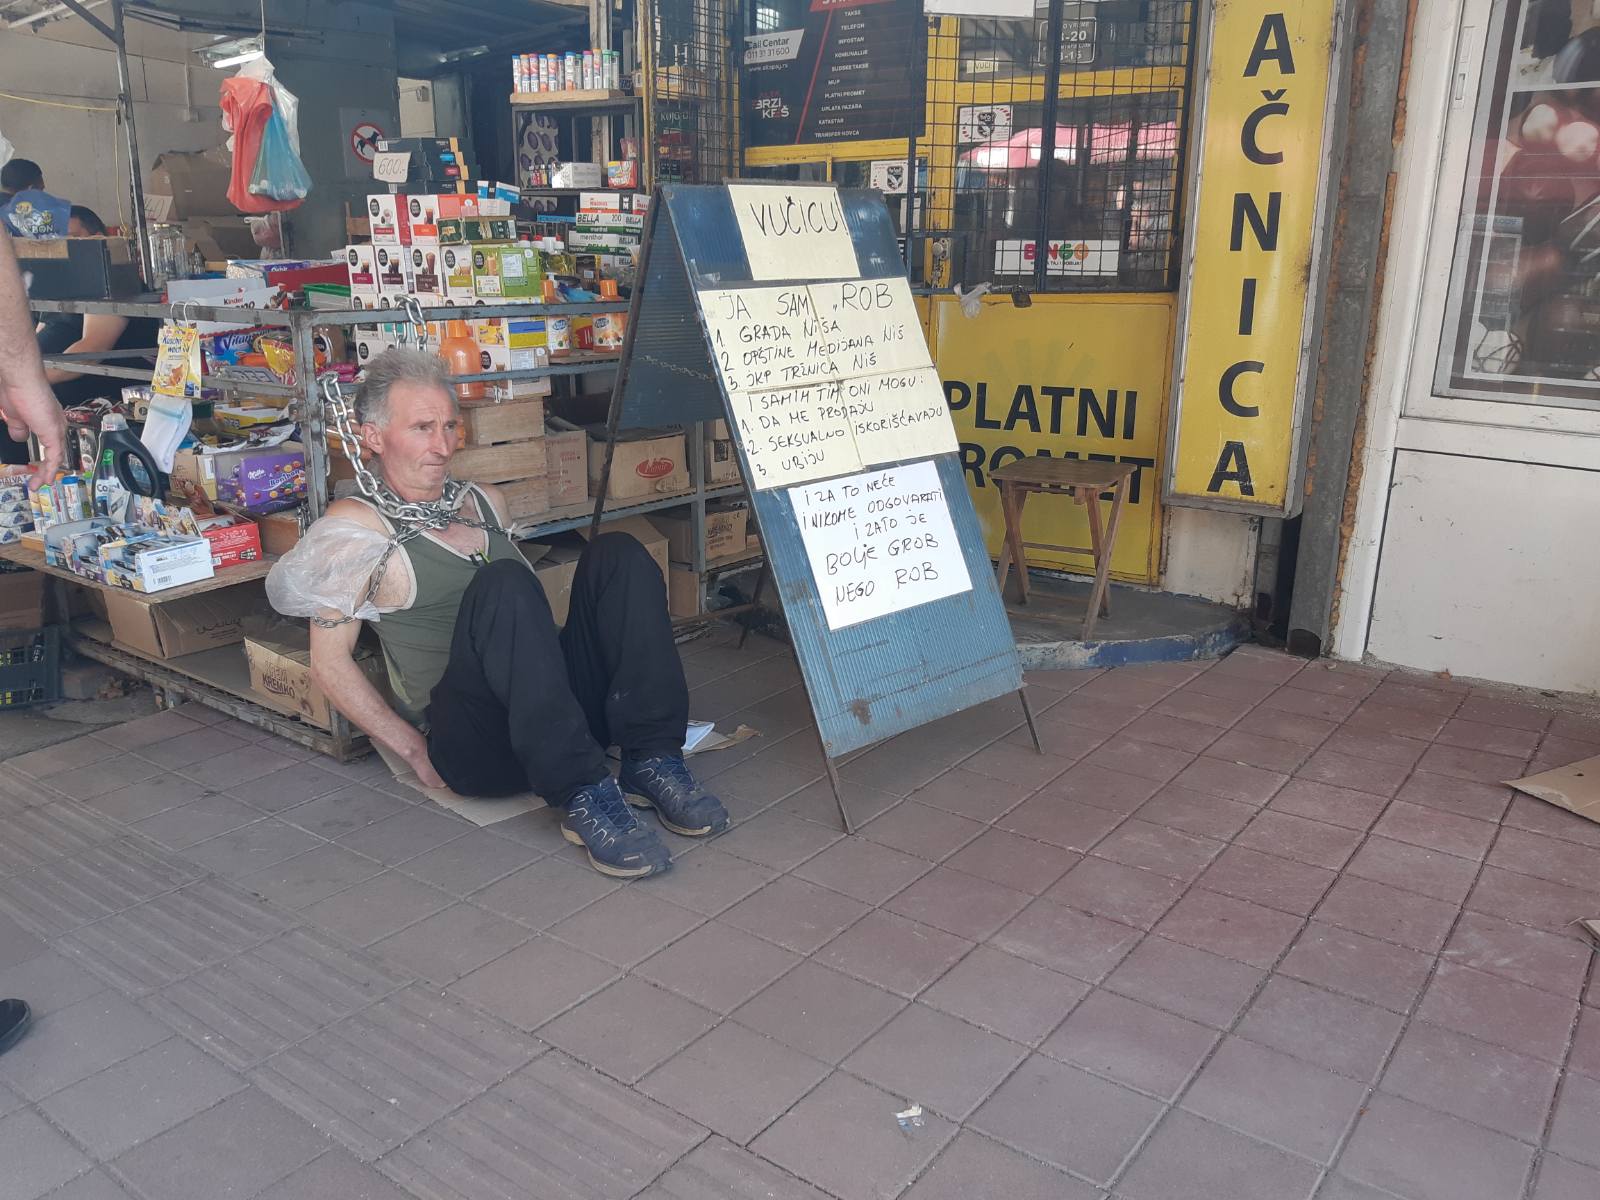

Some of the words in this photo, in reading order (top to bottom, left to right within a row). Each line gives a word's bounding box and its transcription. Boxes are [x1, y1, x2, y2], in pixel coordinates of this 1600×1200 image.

[841, 23, 865, 31] TELEFON
[763, 38, 790, 48] Centar
[824, 91, 842, 99] PLATNI
[843, 89, 865, 97] PROMET
[577, 214, 599, 224] BELLA
[1023, 243, 1090, 261] BNGO
[718, 291, 752, 321] JA
[775, 291, 812, 317] SAM
[739, 324, 792, 344] GRADA
[746, 369, 772, 387] JKP
[758, 413, 781, 429] DA
[789, 408, 810, 424] ME
[942, 380, 1138, 440] PLATNI
[959, 443, 1155, 504] ROT
[887, 532, 939, 557] GROB
[836, 580, 875, 607] NEGO
[894, 561, 939, 590] ROB
